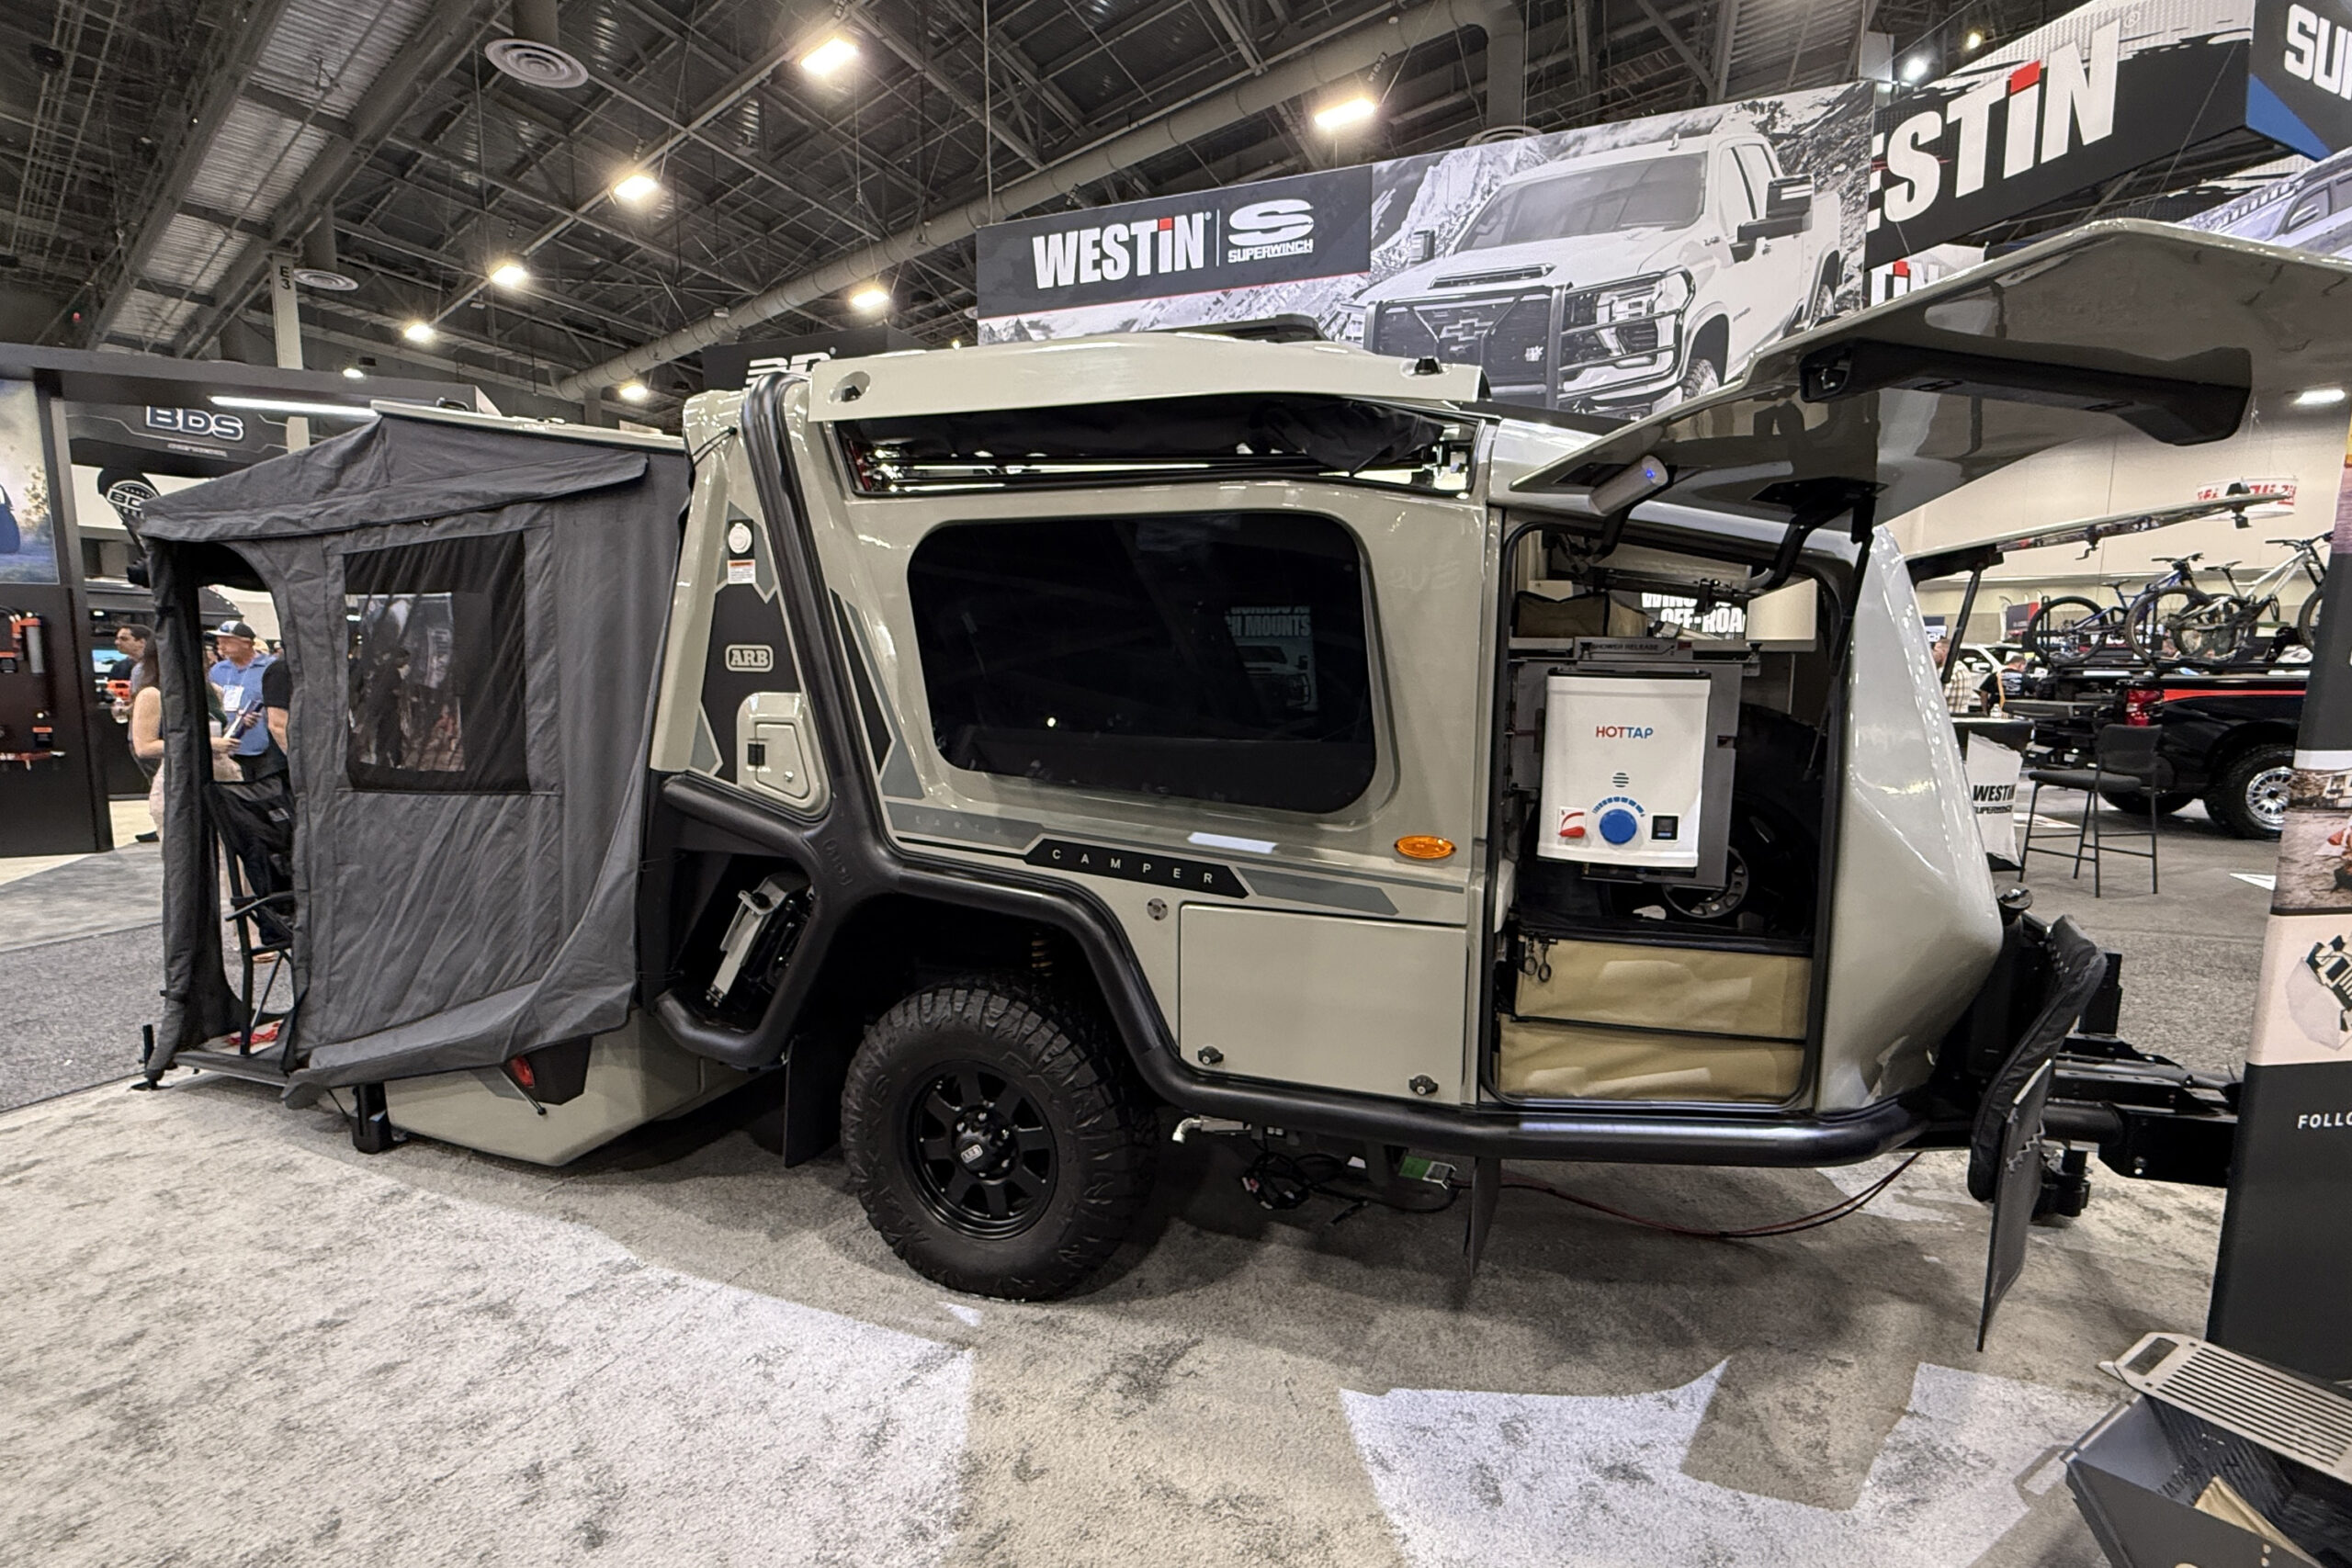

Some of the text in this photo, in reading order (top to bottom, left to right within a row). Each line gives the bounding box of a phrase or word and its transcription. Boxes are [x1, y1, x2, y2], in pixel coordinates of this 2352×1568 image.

[1227, 239, 1314, 264] SUPERWINCH
[146, 405, 244, 441] BDS
[729, 649, 770, 667] ARB
[1595, 726, 1654, 739] HOTTAP
[1052, 849, 1213, 884] CAMPER
